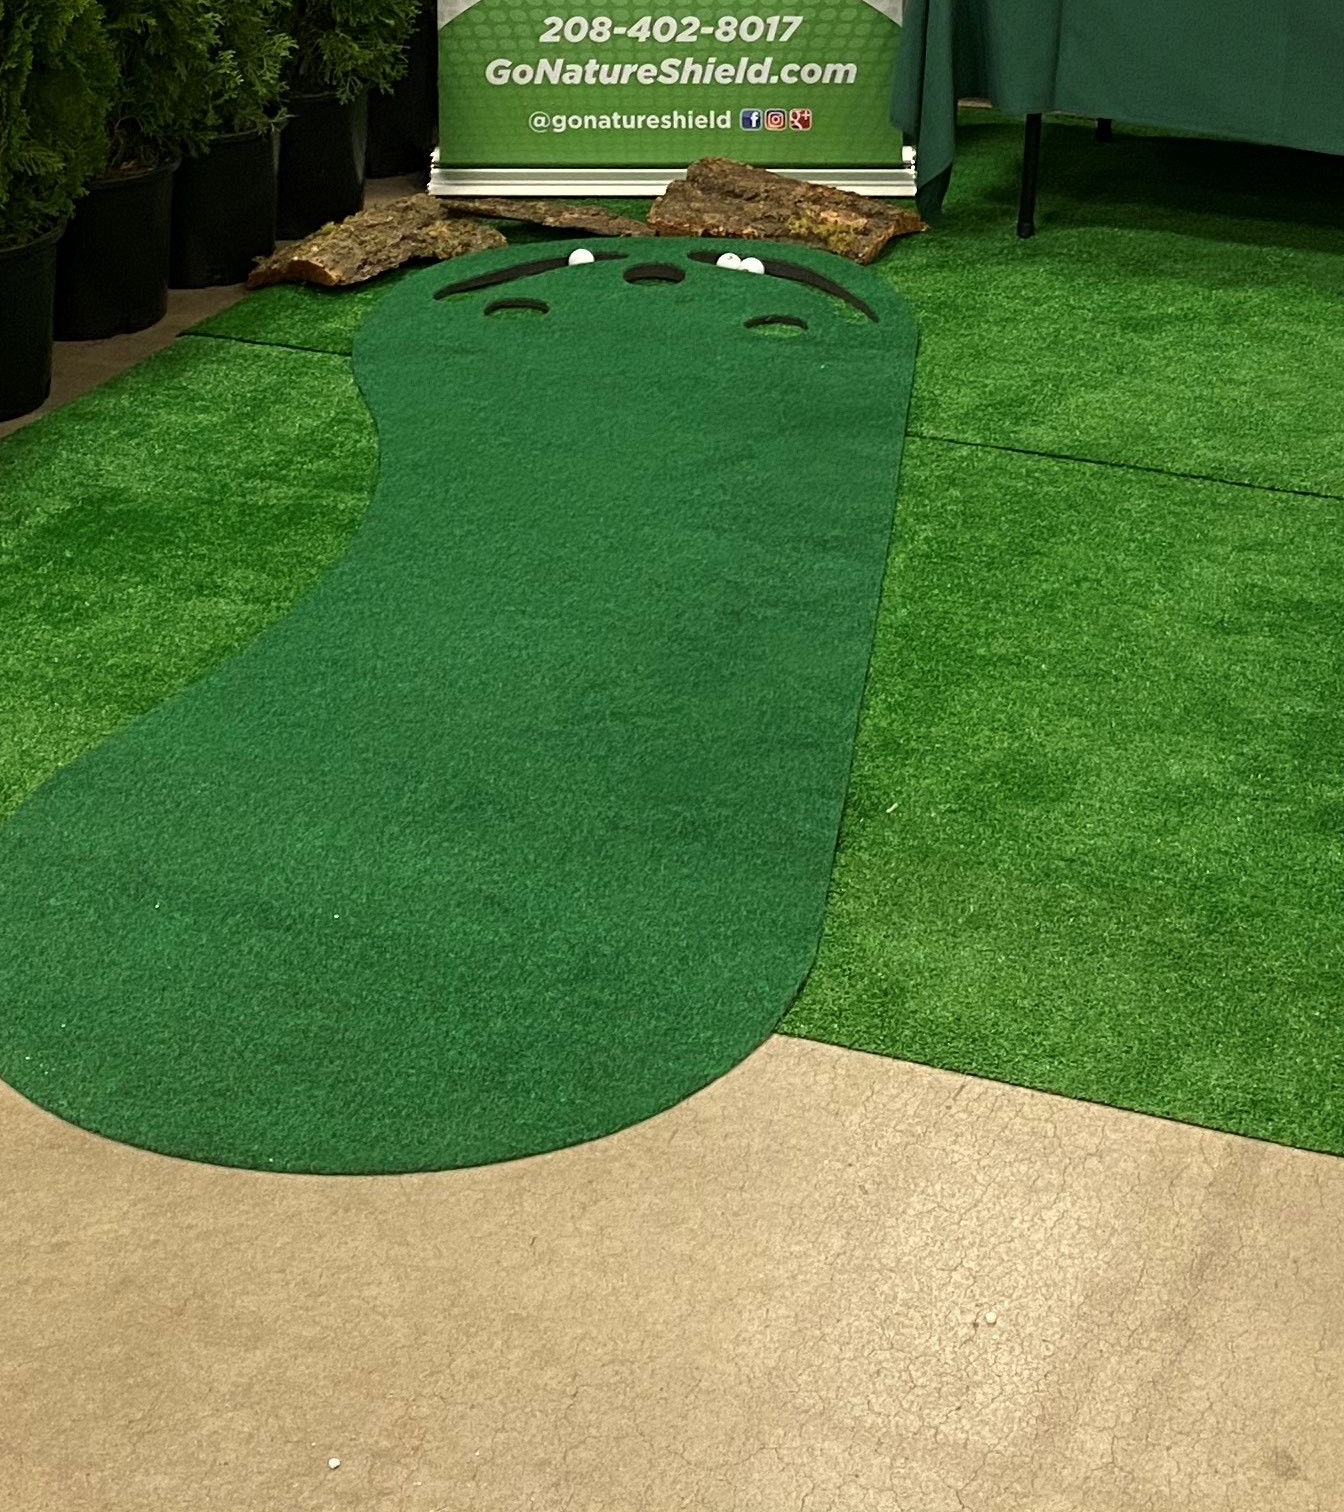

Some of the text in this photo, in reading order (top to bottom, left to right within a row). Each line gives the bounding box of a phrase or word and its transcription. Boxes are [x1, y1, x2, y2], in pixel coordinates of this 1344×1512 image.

[539, 15, 803, 44] 208-402-8017
[485, 57, 857, 86] GoNatureShield.com
[527, 109, 732, 132] @gonatureshield
